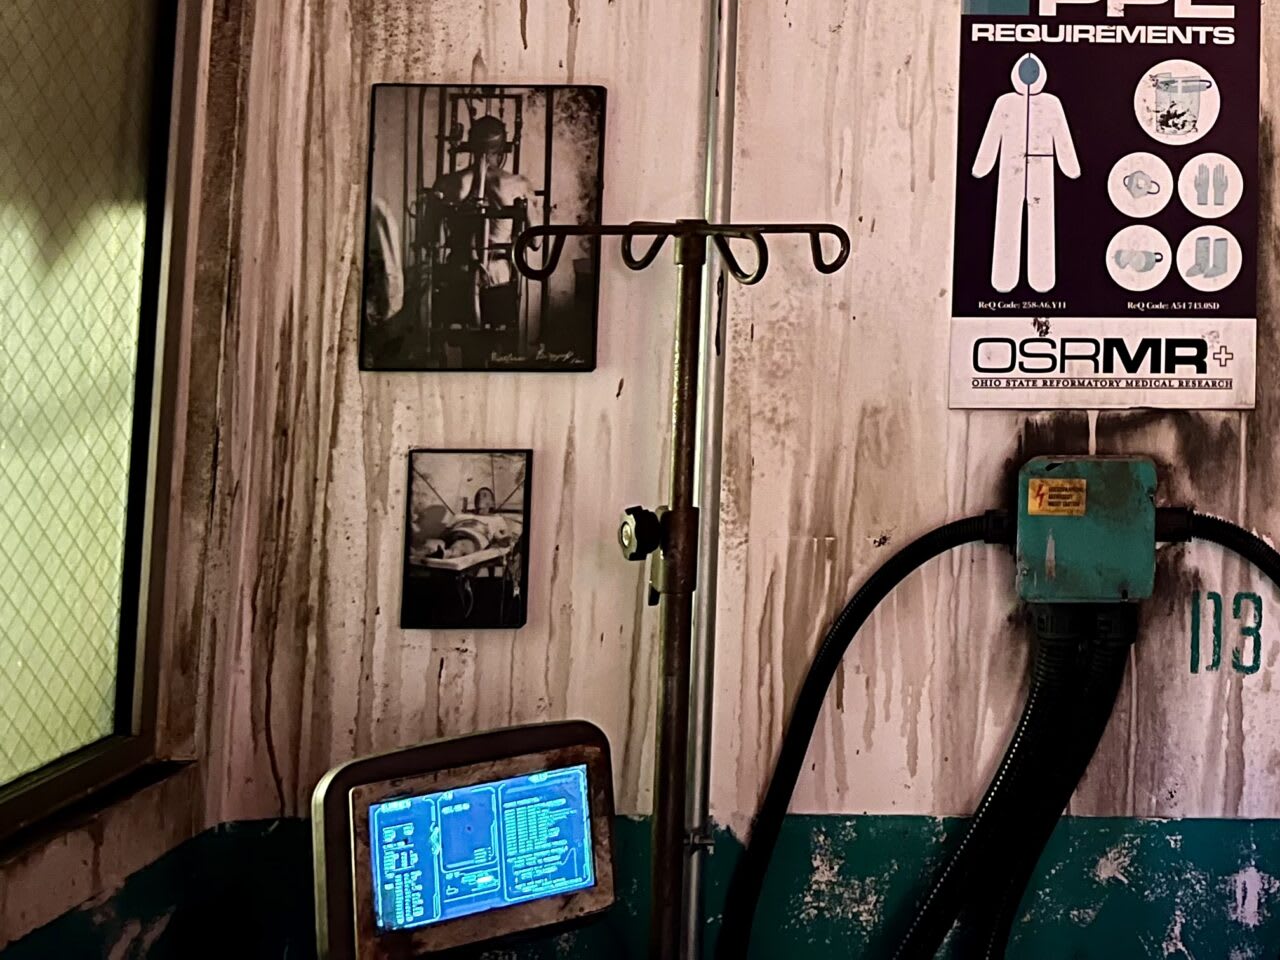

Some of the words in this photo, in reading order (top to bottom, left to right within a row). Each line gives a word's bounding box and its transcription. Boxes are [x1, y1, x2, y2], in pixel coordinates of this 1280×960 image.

[971, 23, 1236, 46] REQUIREMENTS
[972, 379, 1001, 388] OHIO
[1005, 379, 1038, 388] STATE
[1042, 379, 1122, 388] REFORMATORY
[1125, 379, 1175, 389] MEDICAL
[1178, 379, 1233, 389] RESEARCH
